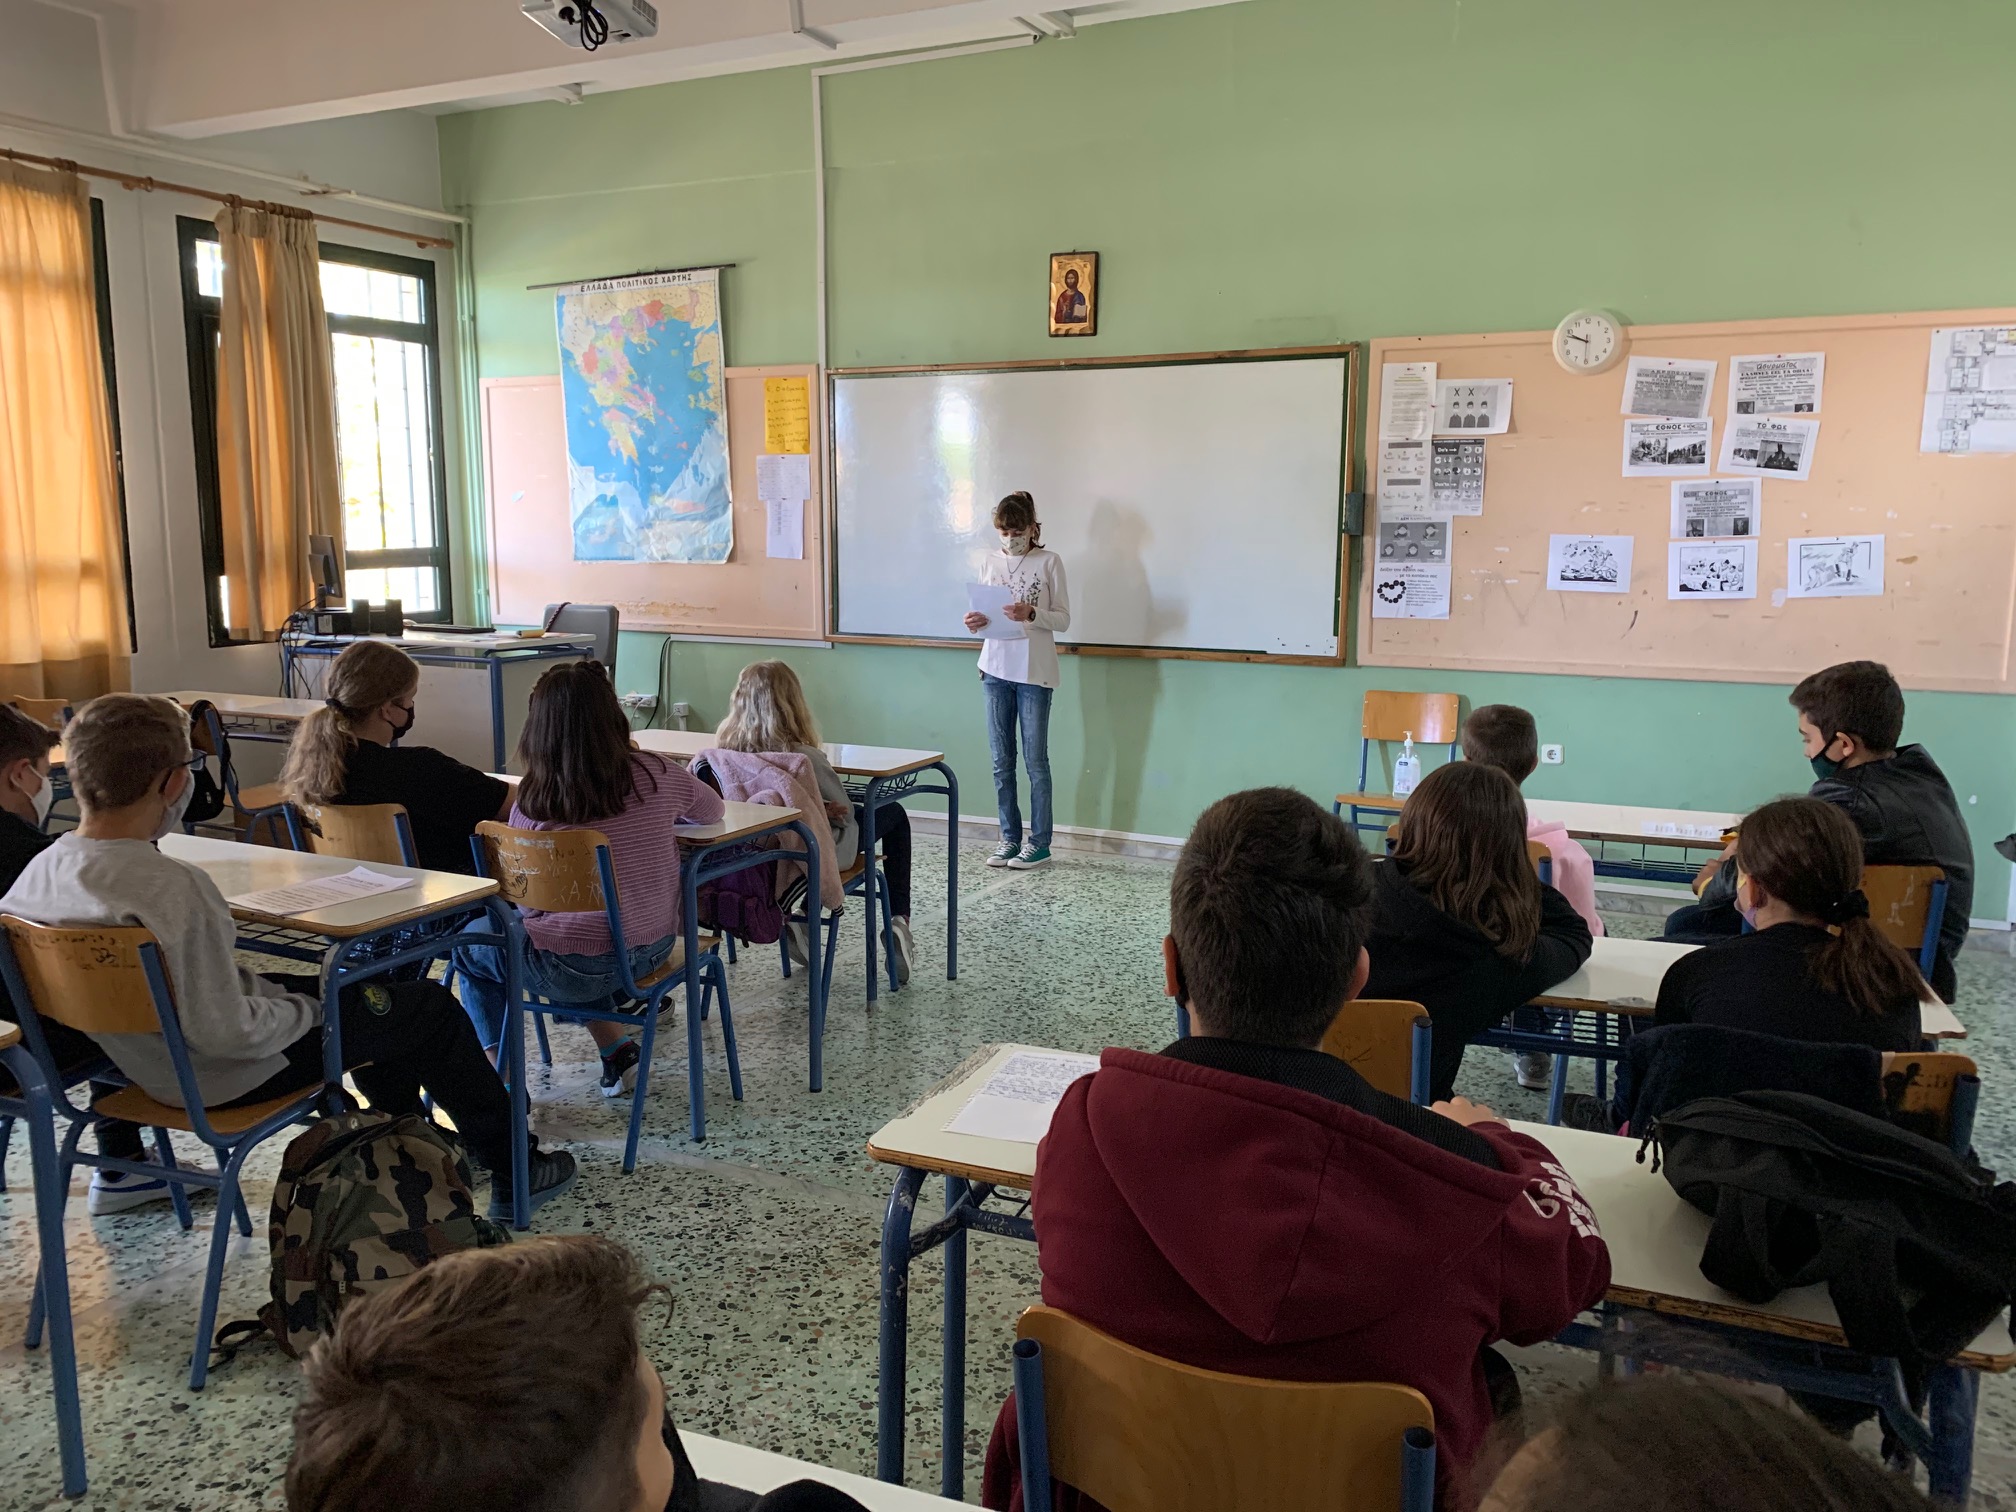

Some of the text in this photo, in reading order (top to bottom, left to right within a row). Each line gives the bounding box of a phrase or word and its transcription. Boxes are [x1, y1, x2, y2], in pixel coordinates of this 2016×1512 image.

[580, 273, 692, 292] ΕΛΛΑΔΑ ΠΟΛΙΤΙΚΟΣ ΧΑΡΤΗΣ
